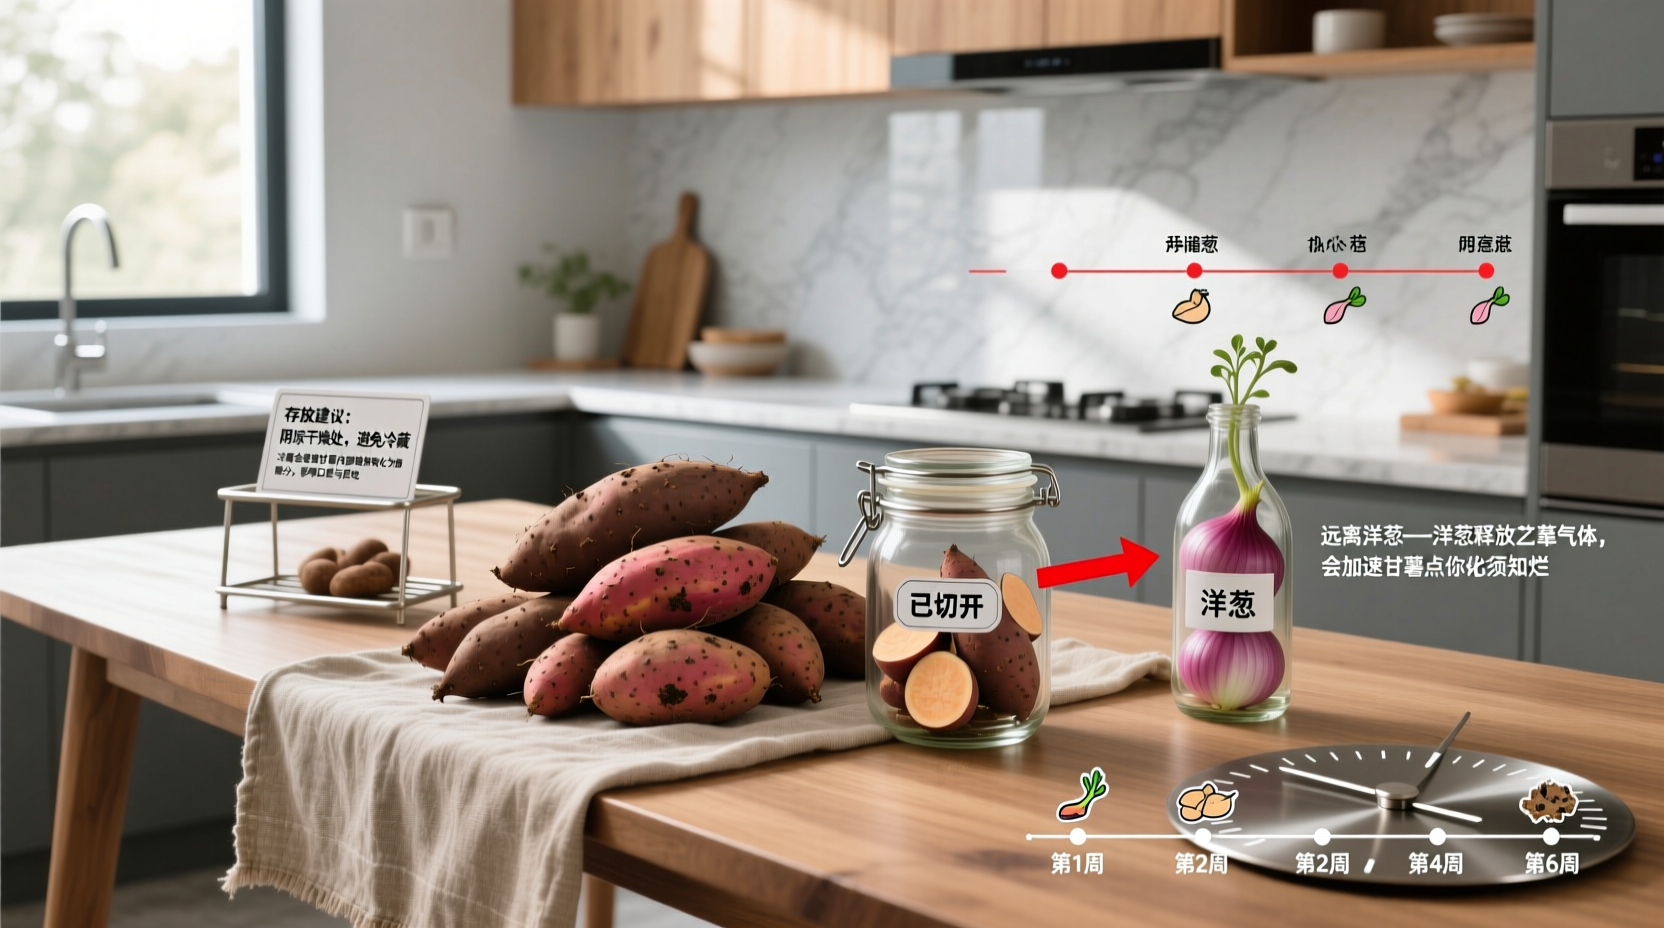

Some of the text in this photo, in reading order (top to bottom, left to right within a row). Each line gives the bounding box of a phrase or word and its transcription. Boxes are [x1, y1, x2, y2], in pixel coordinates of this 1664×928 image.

[910, 591, 984, 620] 已切开
[1201, 588, 1256, 619] 洋葱
